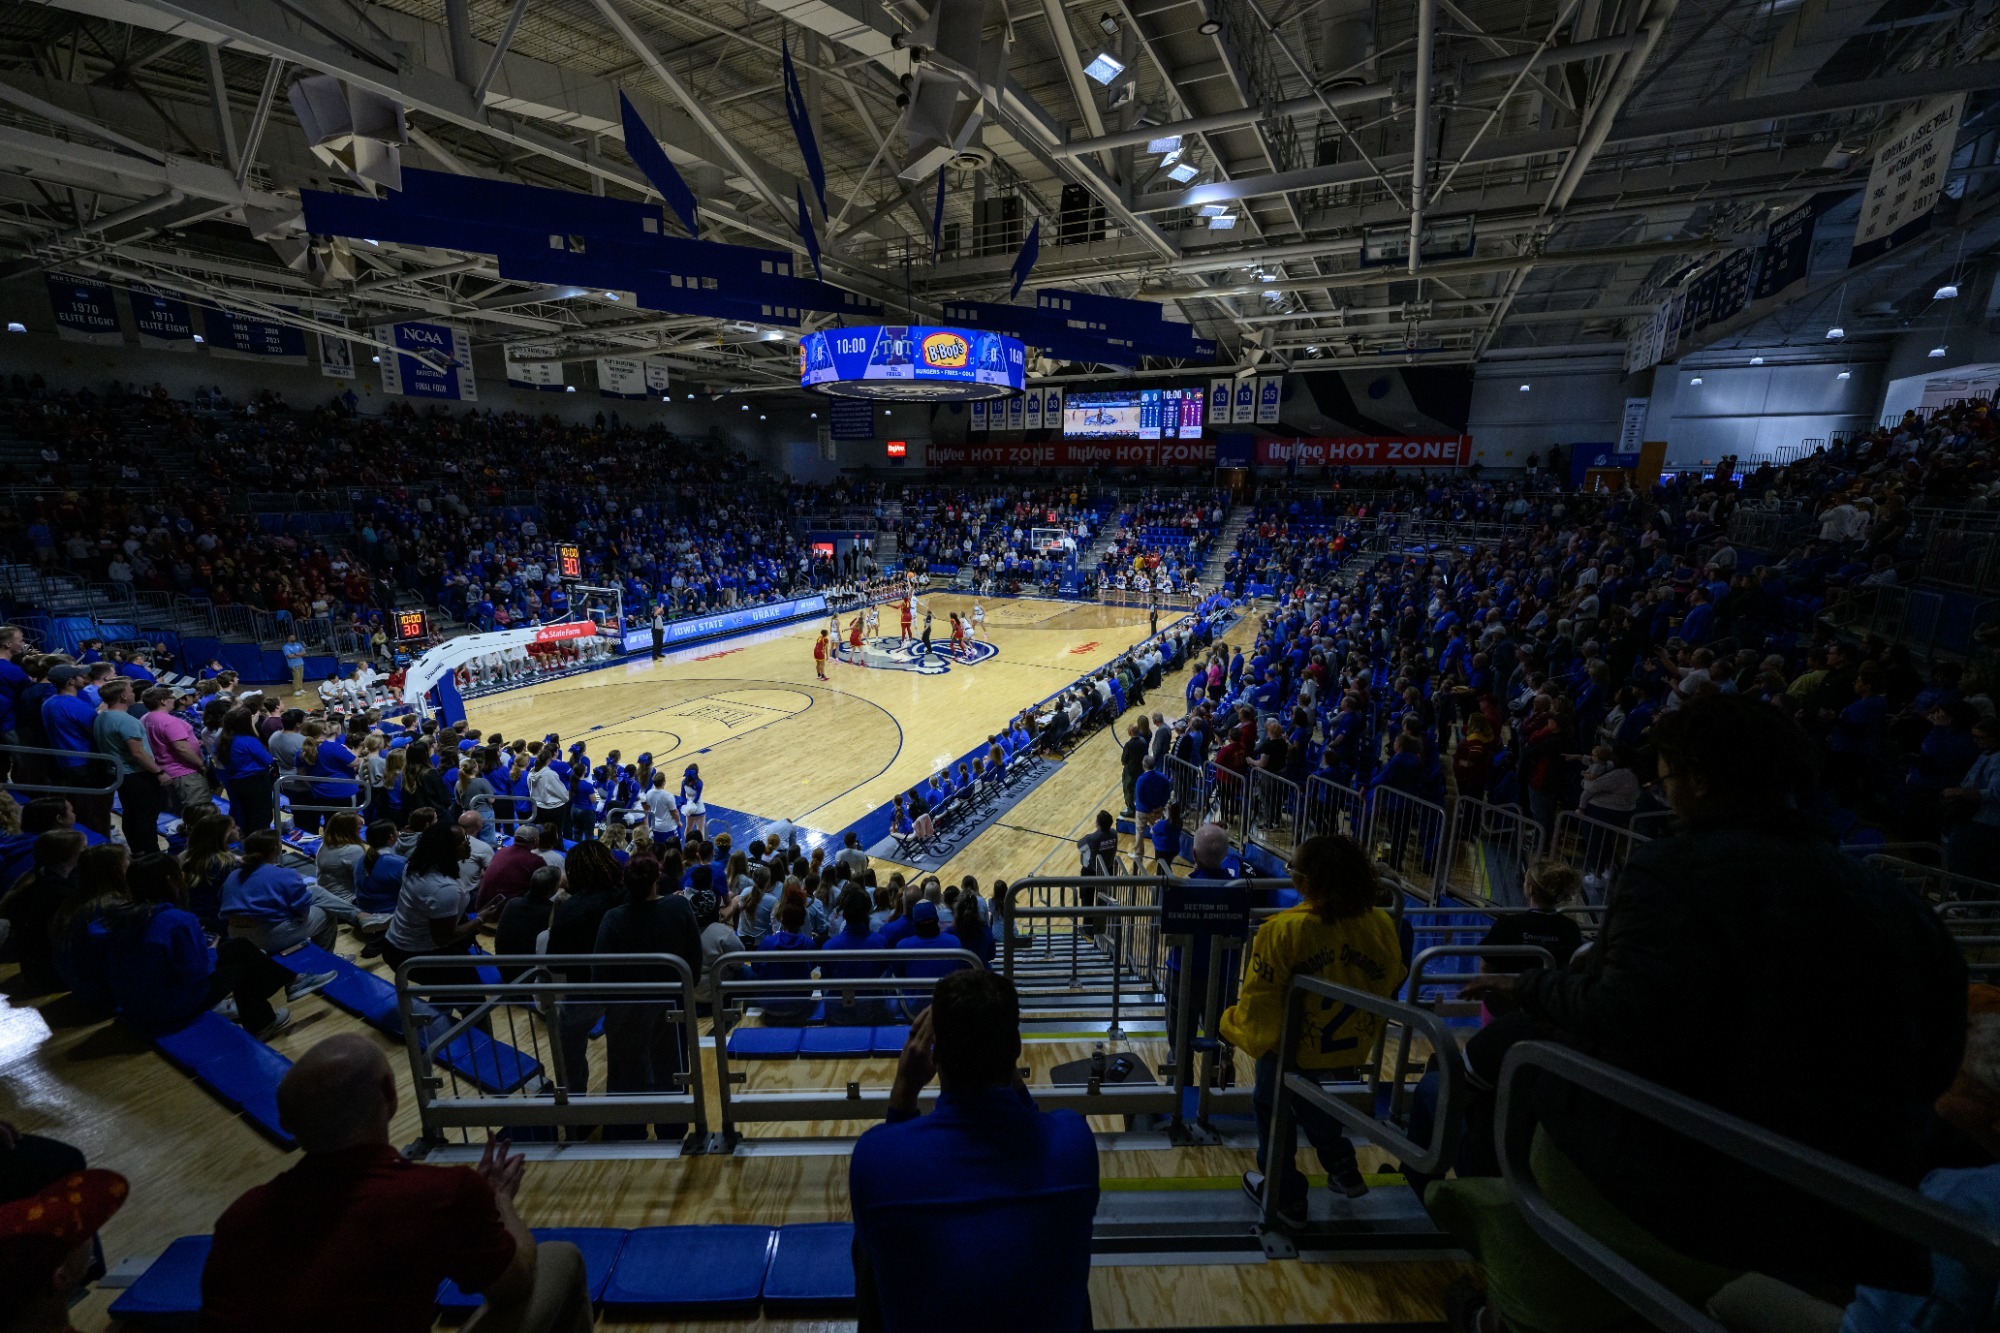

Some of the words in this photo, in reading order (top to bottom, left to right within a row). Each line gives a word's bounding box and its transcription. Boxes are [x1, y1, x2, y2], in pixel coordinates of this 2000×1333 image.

[1913, 194, 1933, 211] 2017
[72, 302, 99, 314] 1970
[60, 312, 86, 323] ELITE
[88, 316, 115, 327] EIGHT
[150, 311, 174, 322] 1971
[140, 321, 163, 331] ELITE
[165, 324, 189, 334] EIGHT
[402, 327, 444, 344] NCAA
[837, 338, 866, 354] 10:00
[415, 382, 431, 391] FINAL
[432, 384, 447, 393] FOUR
[1162, 390, 1182, 400] 10:00
[1216, 393, 1226, 402] 33
[1240, 392, 1250, 401] 13
[1264, 390, 1276, 399] 55
[994, 401, 1002, 411] 15
[1012, 401, 1020, 410] 42
[1030, 401, 1038, 410] 30
[1049, 400, 1058, 409] 33
[928, 444, 965, 463] HyVee
[971, 448, 1003, 461] HOT
[1009, 447, 1055, 461] ZONE
[1068, 446, 1112, 464] HyVee
[1116, 446, 1154, 460] HOT
[1162, 446, 1216, 460] ZONE
[1330, 443, 1380, 460] HOT
[1386, 442, 1458, 459] ZONE
[562, 548, 578, 557] 10:00
[564, 558, 578, 574] 30
[400, 614, 421, 624] 10:00
[674, 624, 696, 636] IOWA
[699, 620, 723, 631] STATE
[752, 607, 780, 620] DRAKE
[403, 624, 419, 636] 30
[1002, 782, 1031, 799] WILLIS
[1028, 765, 1052, 782] LEXUS
[948, 808, 998, 842] LEXUS
[1321, 997, 1358, 1054] 2
